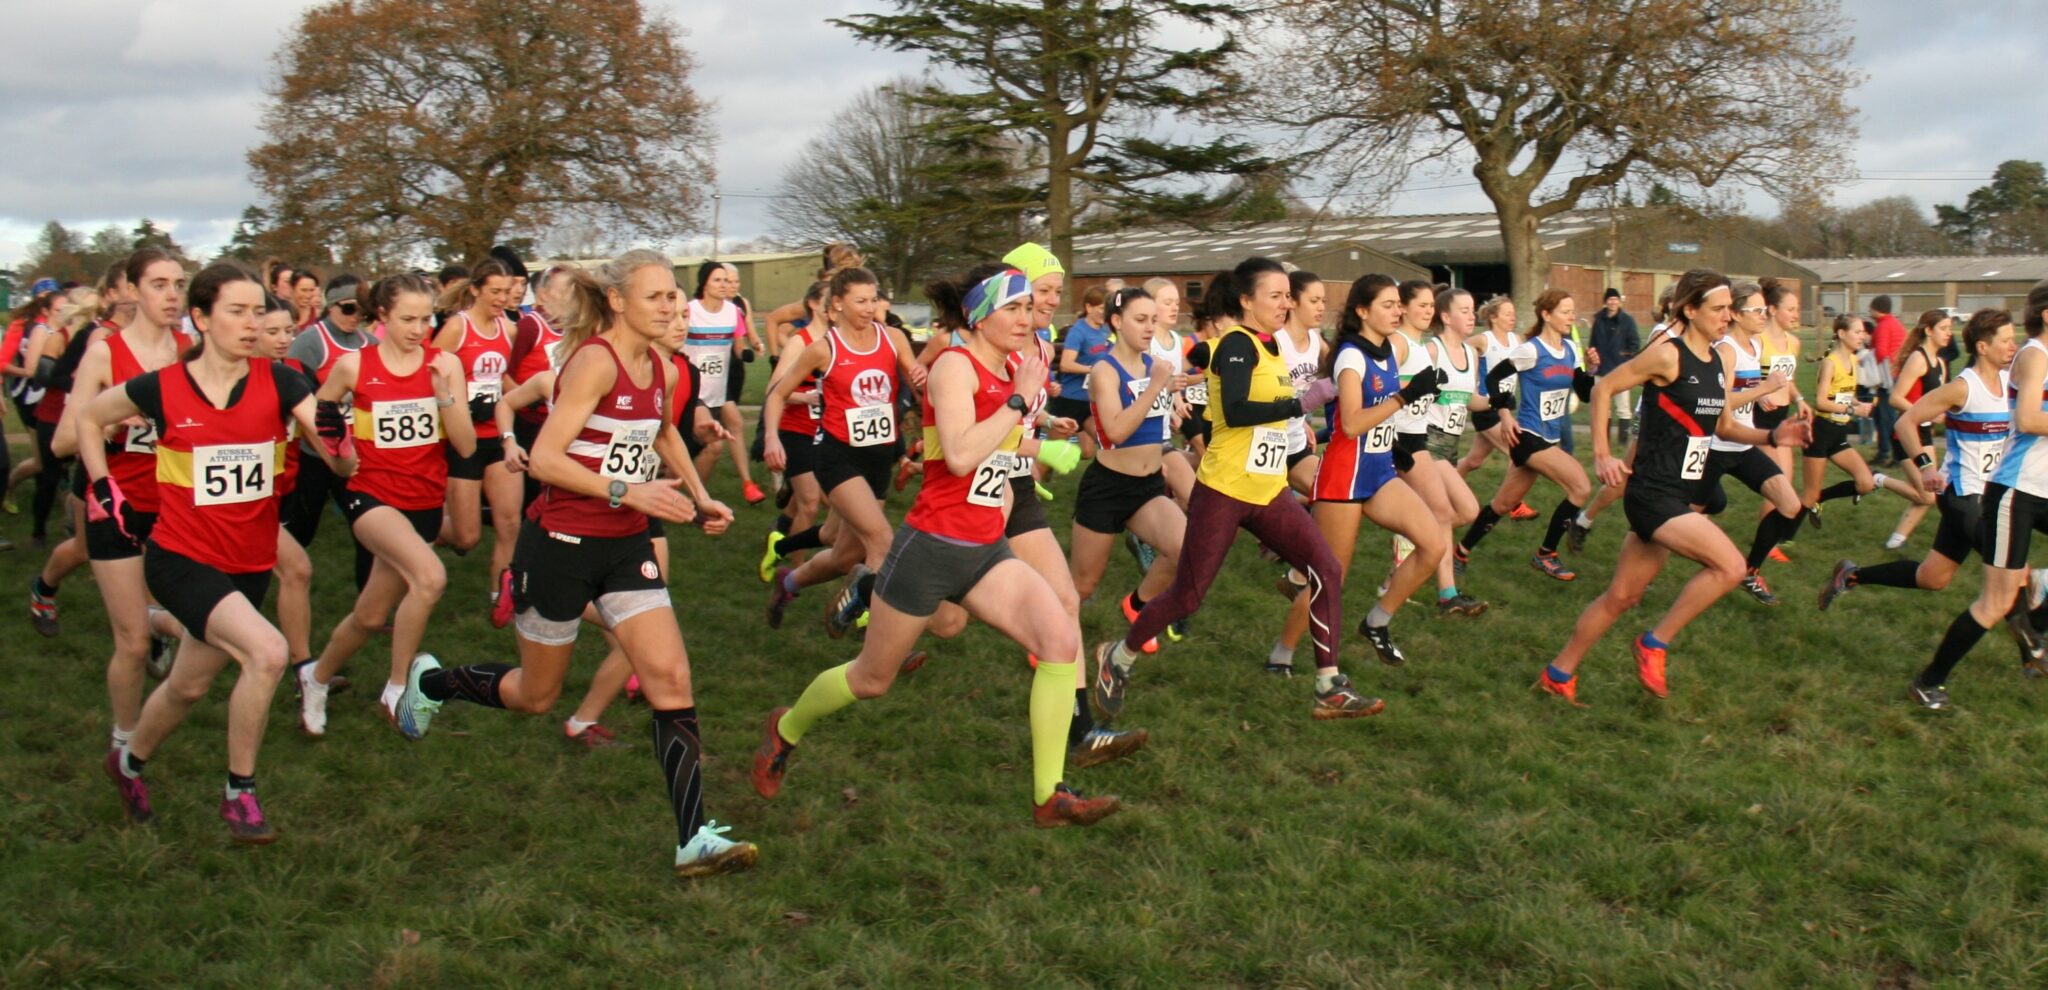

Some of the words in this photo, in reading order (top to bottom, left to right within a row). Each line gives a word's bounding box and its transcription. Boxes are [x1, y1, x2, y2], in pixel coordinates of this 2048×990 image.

[481, 357, 502, 373] HY
[700, 360, 723, 375] 465
[858, 375, 885, 395] HY
[1543, 397, 1564, 416] 327
[378, 413, 434, 442] 583
[852, 416, 891, 442] 549
[1372, 425, 1395, 448] 50
[209, 454, 261, 463] ATHLETICS
[217, 448, 253, 456] SUSSEX
[1254, 442, 1286, 469] 317
[205, 463, 265, 497] 514
